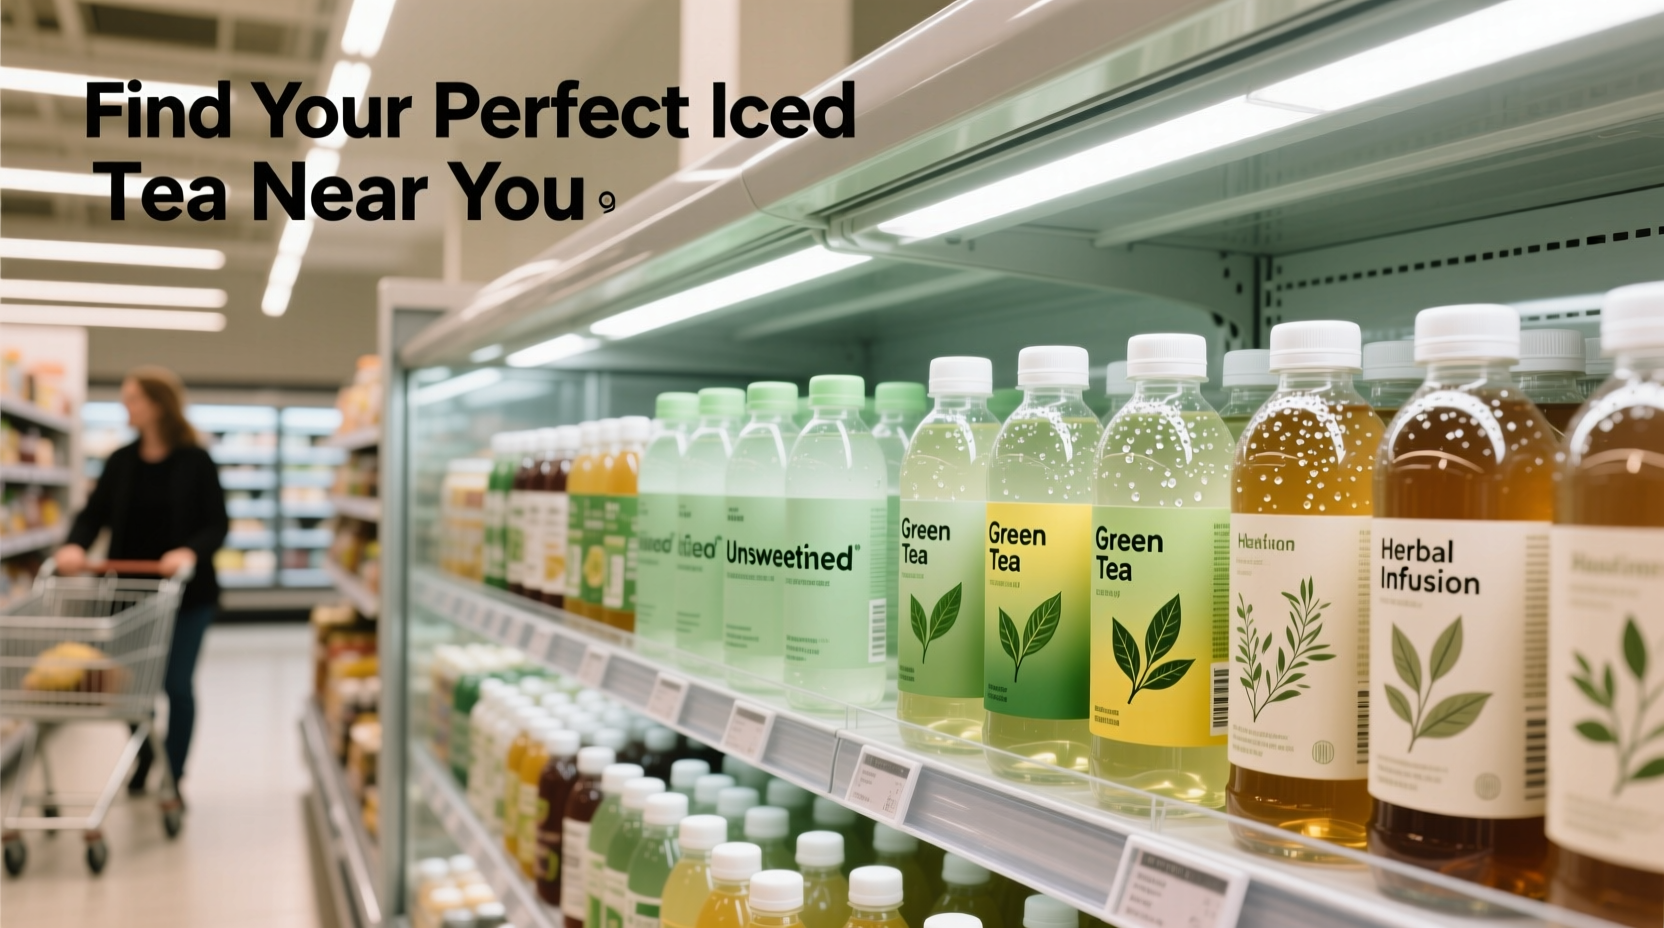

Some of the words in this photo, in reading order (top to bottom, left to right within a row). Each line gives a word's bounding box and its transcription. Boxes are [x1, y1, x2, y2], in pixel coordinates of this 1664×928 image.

[901, 517, 951, 542] Green
[988, 521, 1047, 546] Green
[1095, 525, 1164, 553] Green
[901, 543, 928, 565] Tea
[989, 547, 1021, 573] Tea
[1381, 537, 1454, 564] Herbal
[1095, 554, 1132, 582] Tea
[1381, 566, 1480, 595] Infusion
